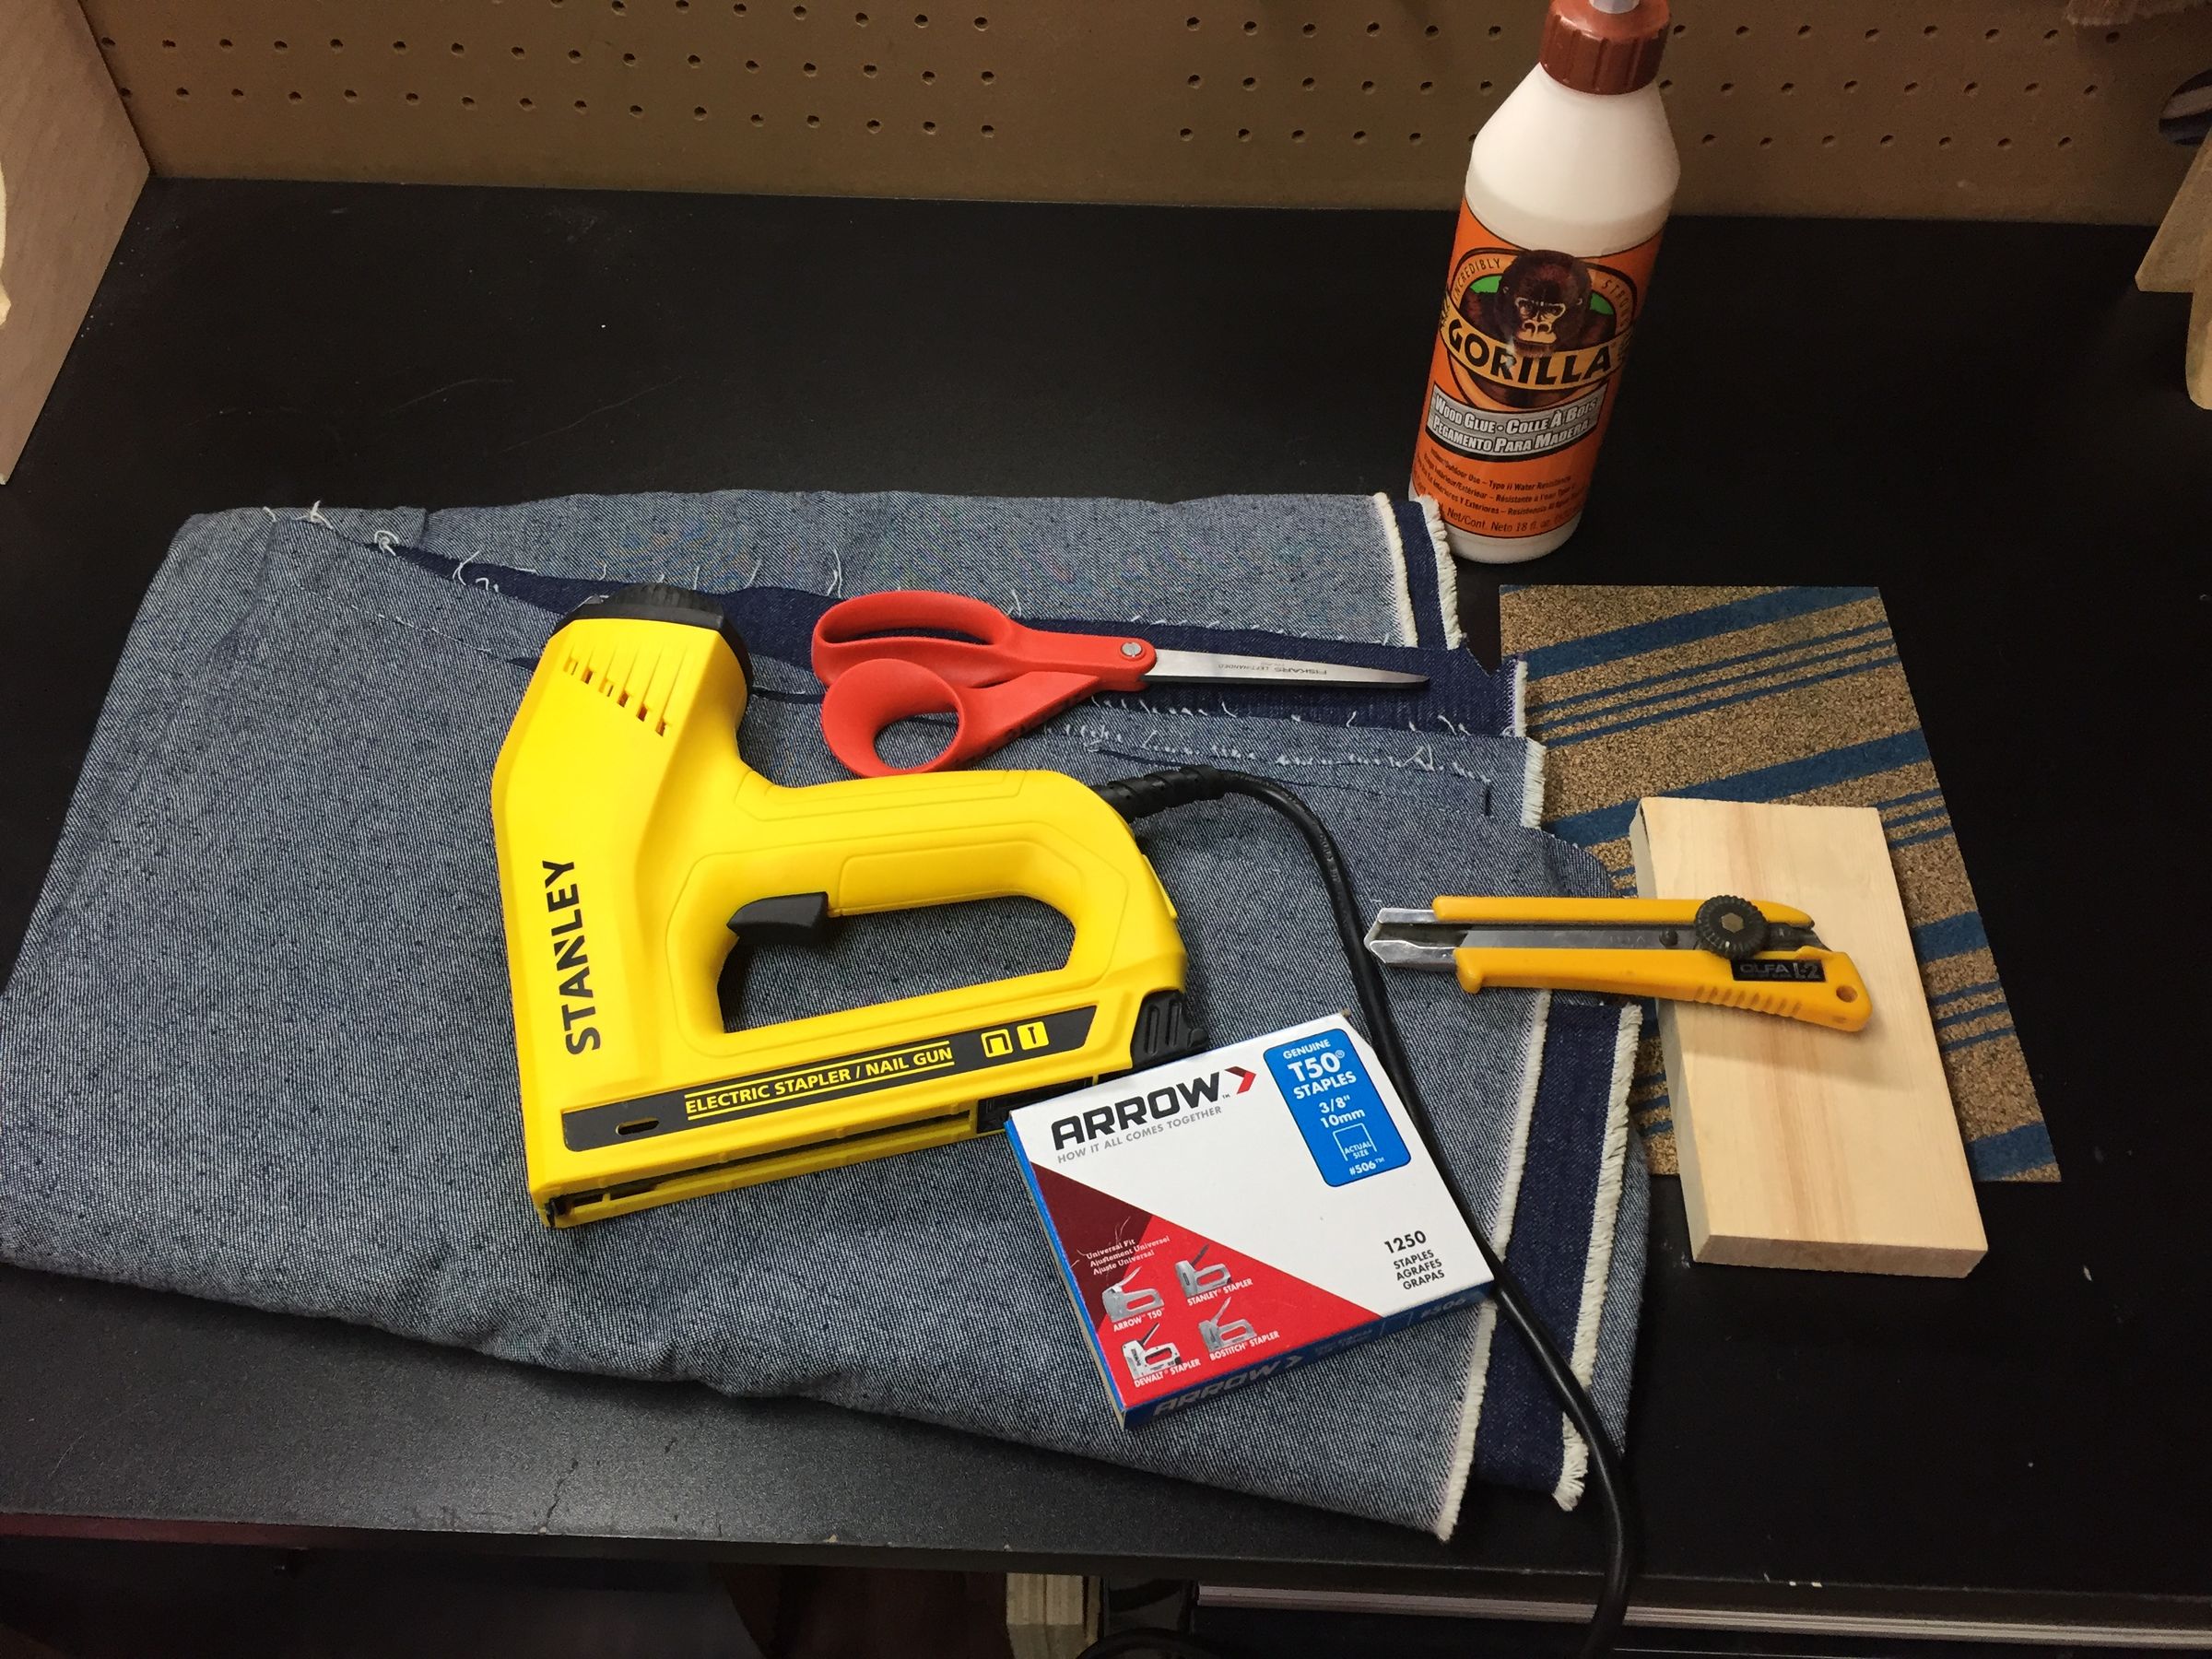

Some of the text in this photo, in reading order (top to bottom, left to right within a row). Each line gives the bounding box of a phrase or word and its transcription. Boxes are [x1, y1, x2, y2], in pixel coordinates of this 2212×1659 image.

[1453, 258, 1500, 301] INCREDIBLY
[1448, 319, 1611, 384] GORILLA
[1514, 483, 1535, 491] Water
[1491, 522, 1512, 532] Neto
[541, 860, 601, 1055] STANLEY
[1283, 1040, 1331, 1059] GENUINE
[685, 1085, 770, 1114] ELECTRIC
[775, 1069, 851, 1095] STAPLER
[865, 1057, 909, 1077] NAIL
[912, 1048, 953, 1065] GUN
[1293, 1071, 1357, 1100] STAPLES
[1052, 1072, 1219, 1150] ARROW
[1319, 1095, 1350, 1114] 3/8"
[1321, 1110, 1365, 1128] 10mm
[1057, 1106, 1221, 1163] HOW IT ALL COMES TOGETHER
[1345, 1142, 1371, 1154] ACTUAL
[1353, 1149, 1370, 1159] SIZE
[1087, 1239, 1135, 1259] Universal Fit
[1383, 1230, 1427, 1253] 1250
[1093, 1250, 1155, 1276] Ajuste Universal
[1394, 1250, 1434, 1269] STAPLES
[1396, 1259, 1442, 1280] AGRAFES
[1403, 1270, 1444, 1290] GRAPAS
[1187, 1278, 1253, 1306] STANLEY STAPLER
[1113, 1317, 1142, 1332] ARROW
[1209, 1331, 1279, 1360] BOSTITCH STAPLER
[1134, 1359, 1201, 1387] DEWALT STAPLER
